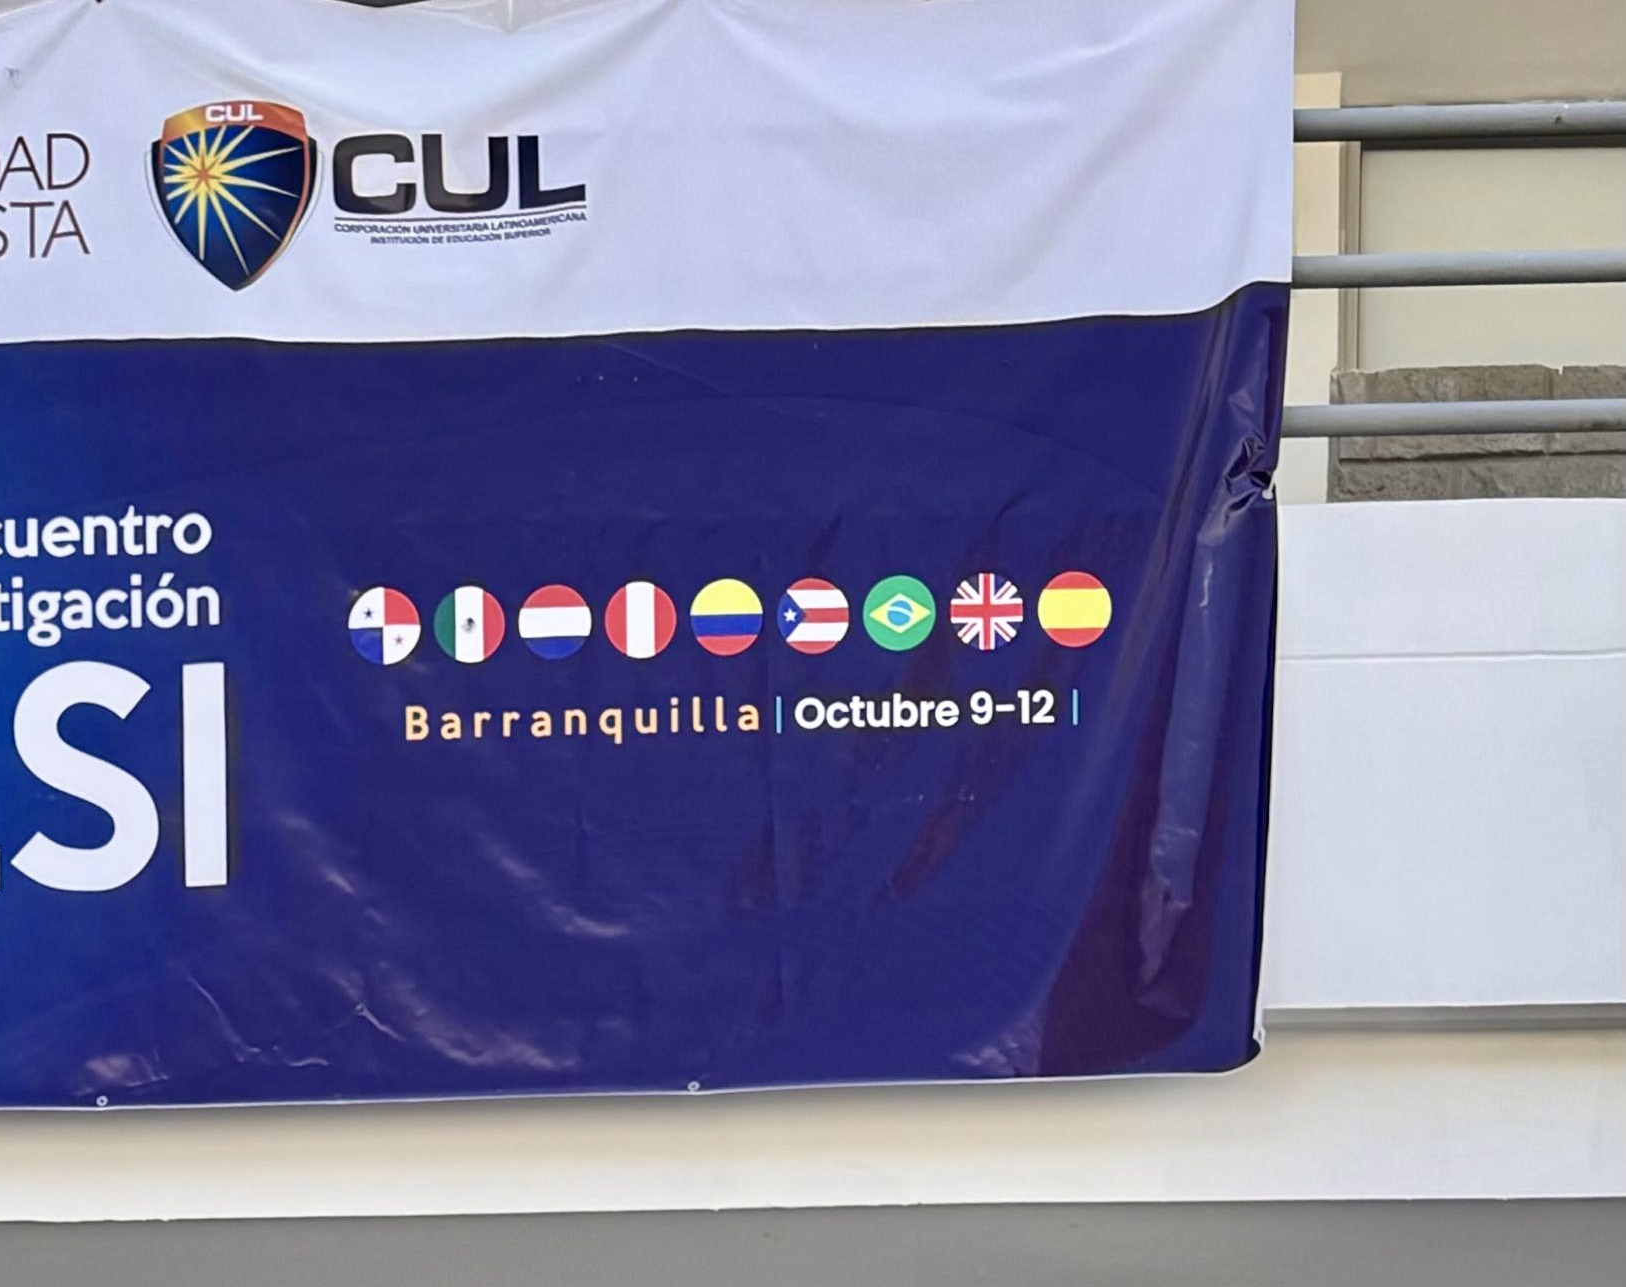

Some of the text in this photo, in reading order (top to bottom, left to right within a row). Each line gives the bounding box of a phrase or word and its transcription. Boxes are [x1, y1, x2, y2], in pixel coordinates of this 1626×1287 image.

[205, 103, 264, 123] CUL
[332, 133, 587, 215] CUL
[405, 690, 1056, 745] Barranquilla Octubre 9-12
